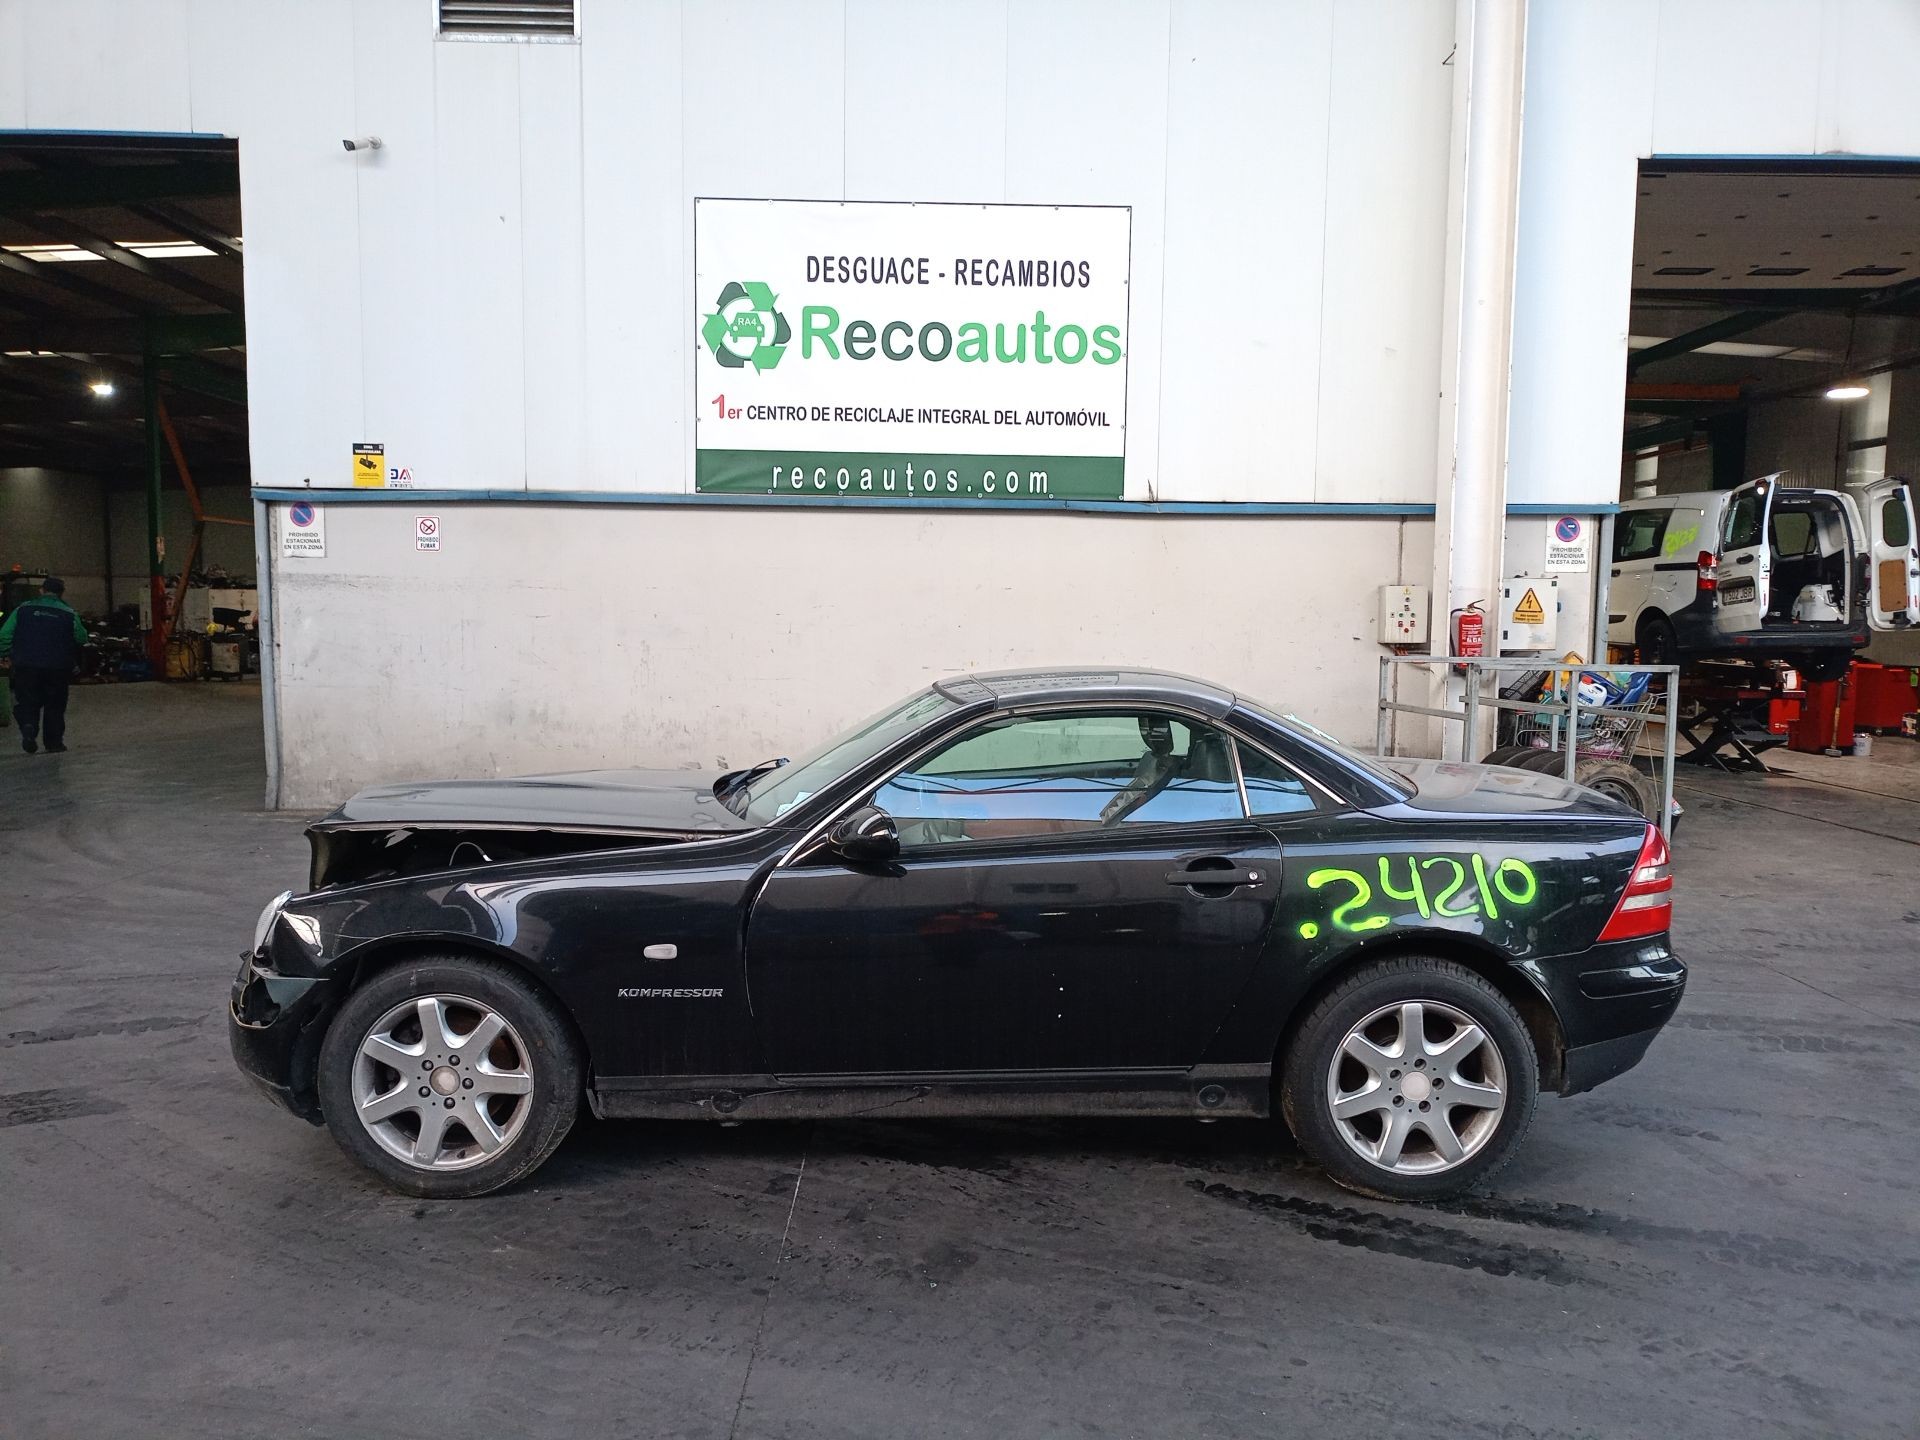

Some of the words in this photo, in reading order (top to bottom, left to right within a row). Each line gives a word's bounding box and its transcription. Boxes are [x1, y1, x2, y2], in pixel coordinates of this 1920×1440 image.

[806, 255, 930, 285] DESGUACE
[954, 258, 1091, 288] RECAMBIOS
[737, 317, 757, 326] RA4
[800, 304, 1124, 366] Recoautos
[712, 394, 743, 420] 1er
[746, 404, 807, 422] CENTRO
[811, 406, 831, 422] DE
[834, 406, 914, 423] RECICLAJE
[918, 408, 991, 425] INTEGRAL
[994, 410, 1022, 426] DEL
[1024, 407, 1111, 427] AUTOMÓVIL
[771, 462, 1049, 494] recoautos.com
[617, 987, 724, 999] KOMPRESSOR
